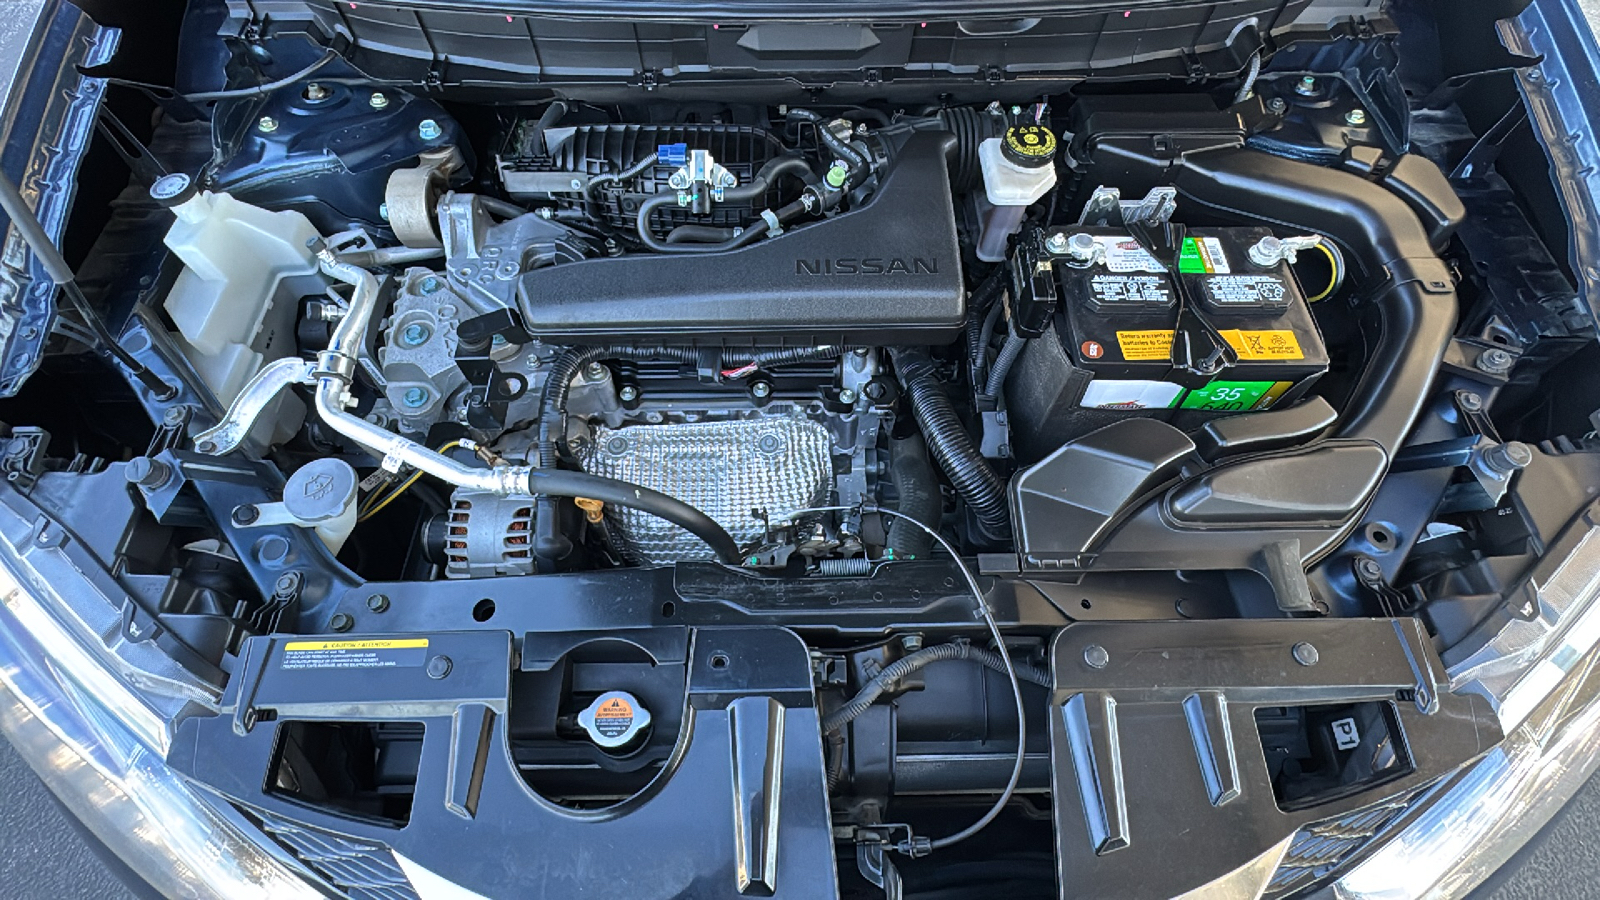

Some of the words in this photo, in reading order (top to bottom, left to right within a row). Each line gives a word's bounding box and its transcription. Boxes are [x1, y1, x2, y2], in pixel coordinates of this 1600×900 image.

[795, 257, 940, 277] NISSAN
[1210, 387, 1246, 401] 35
[1336, 721, 1356, 746] P1
